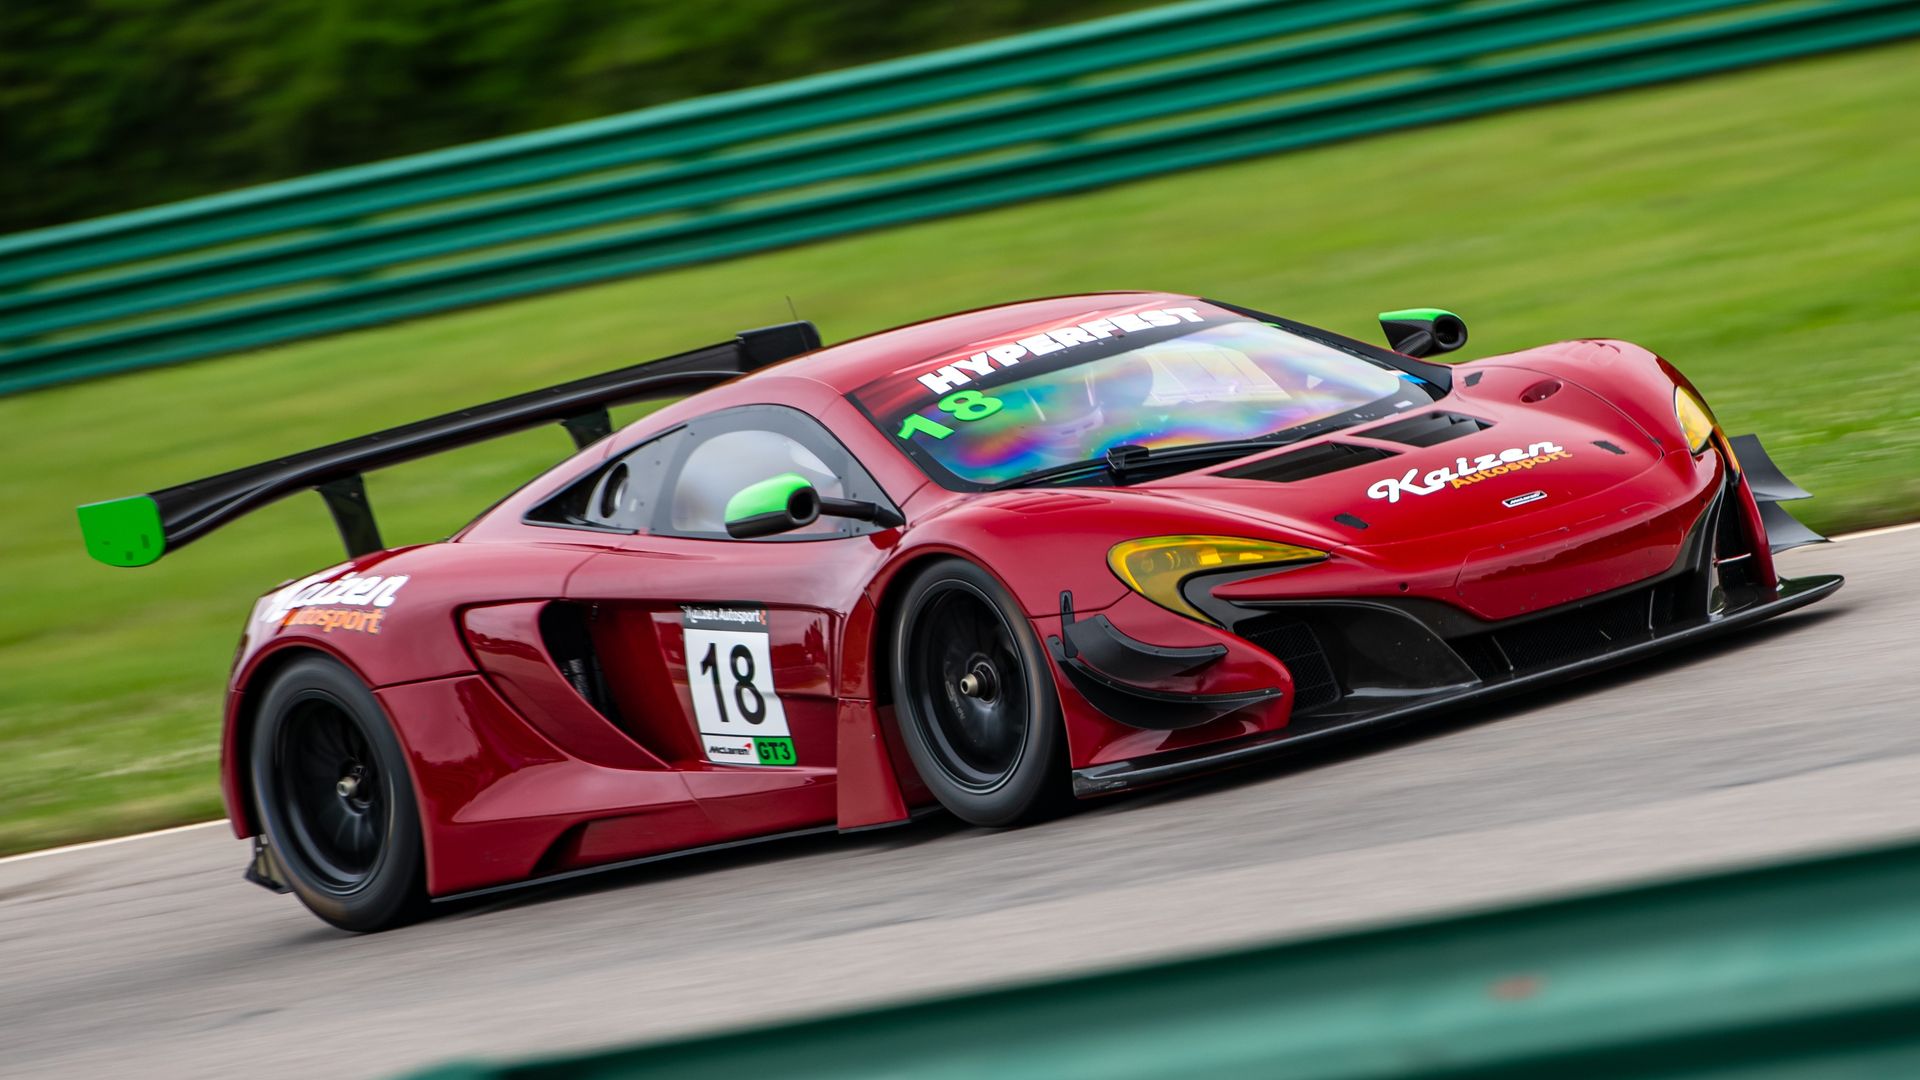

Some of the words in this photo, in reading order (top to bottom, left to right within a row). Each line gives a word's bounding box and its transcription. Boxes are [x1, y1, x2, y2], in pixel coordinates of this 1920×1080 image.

[916, 307, 1205, 394] HYPERFEST
[896, 389, 1004, 440] 18
[1366, 441, 1563, 504] Kaizen
[1450, 449, 1573, 489] Autosport
[700, 642, 766, 725] 18
[758, 741, 791, 760] GT3
